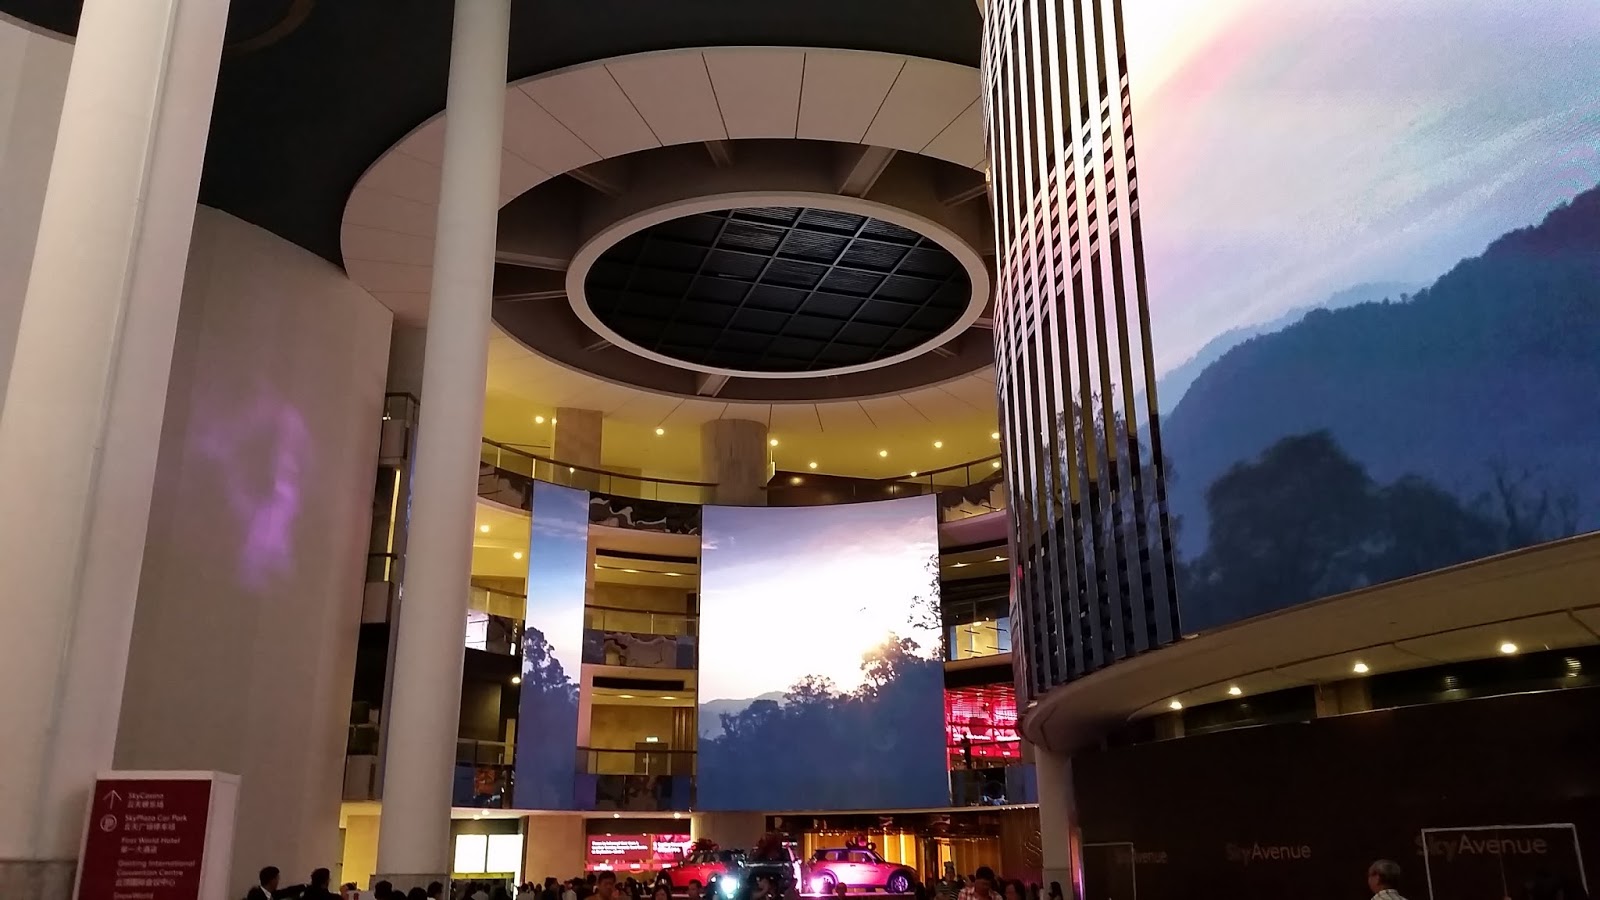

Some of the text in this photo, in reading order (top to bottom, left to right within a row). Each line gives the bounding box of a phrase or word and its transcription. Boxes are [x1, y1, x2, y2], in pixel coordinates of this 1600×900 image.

[125, 814, 156, 822] SkyPlaza
[1225, 842, 1311, 867] SkyAvenue
[1415, 833, 1548, 862] SkyAvenue
